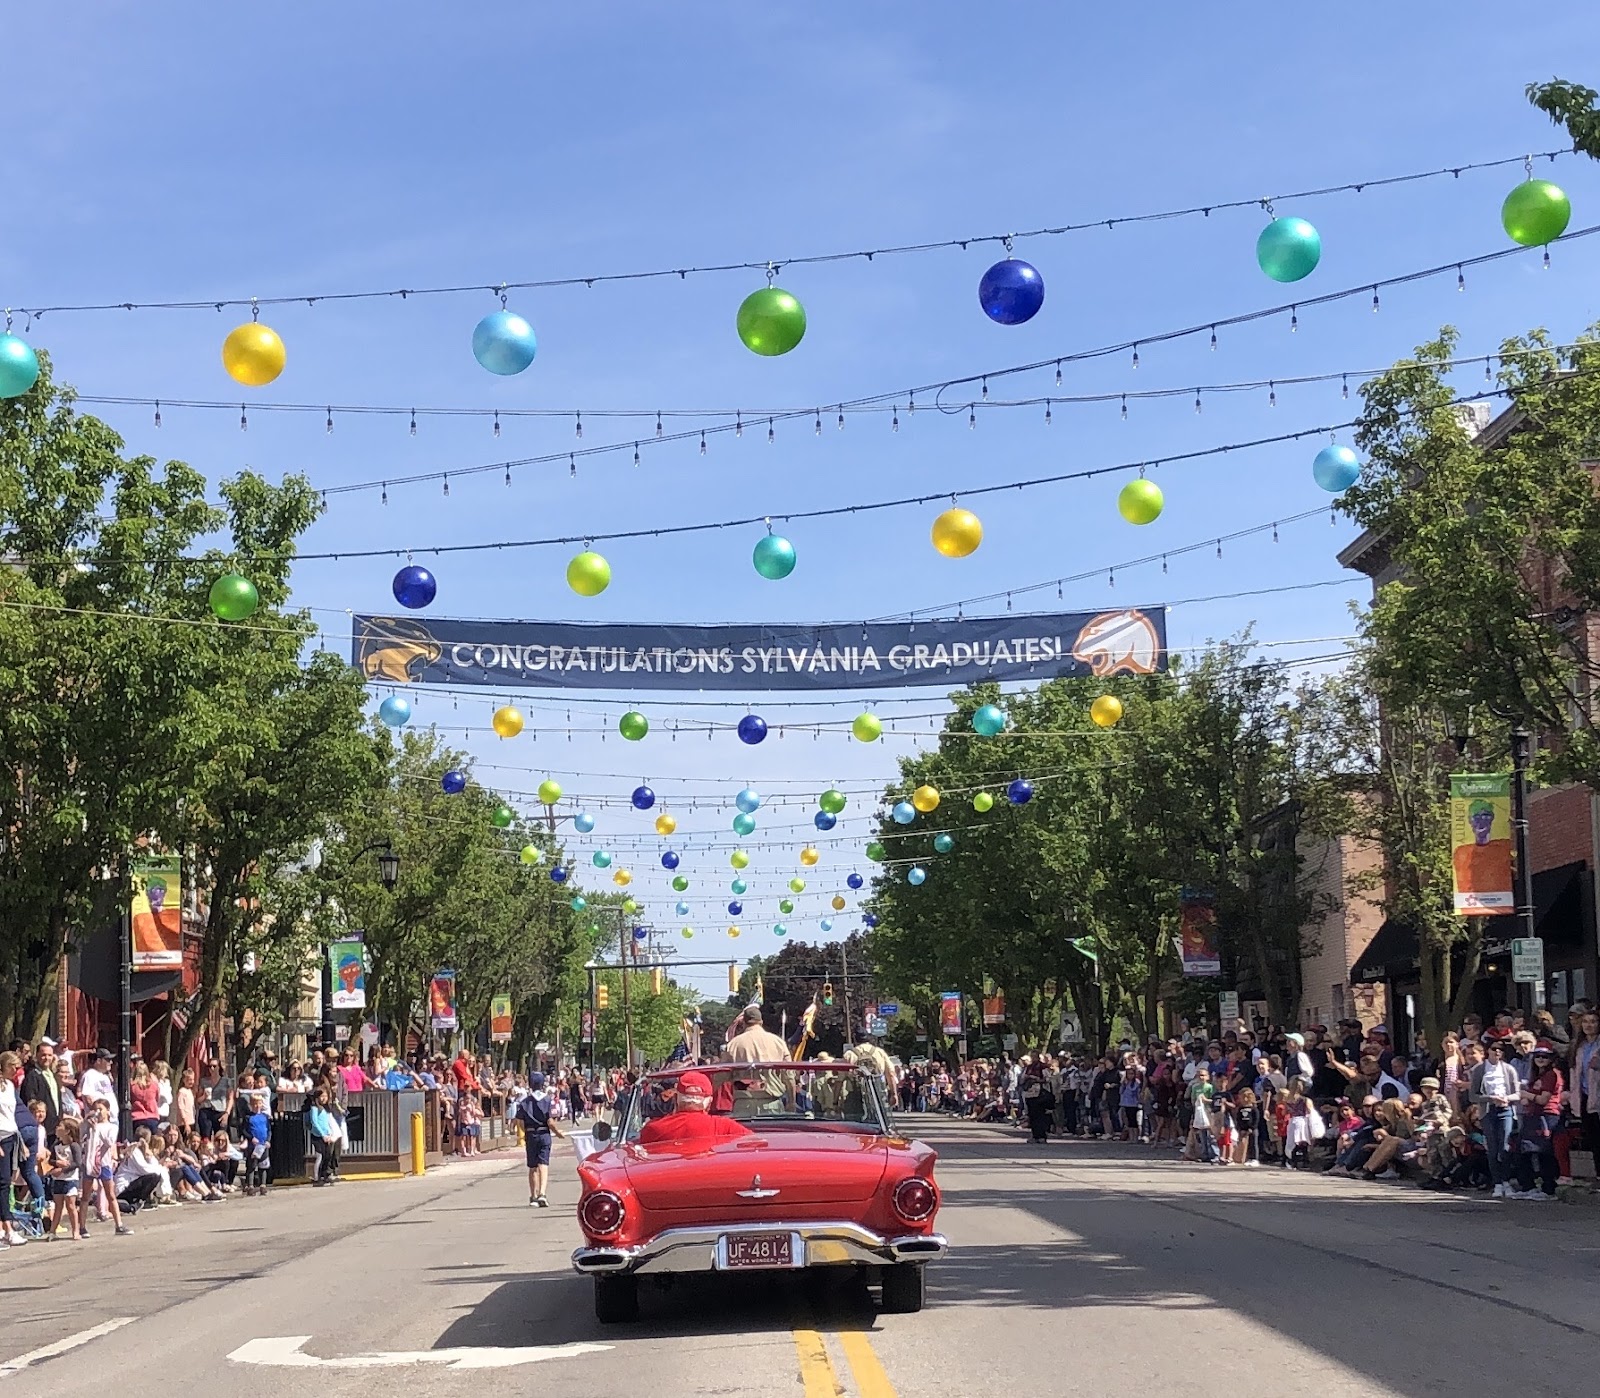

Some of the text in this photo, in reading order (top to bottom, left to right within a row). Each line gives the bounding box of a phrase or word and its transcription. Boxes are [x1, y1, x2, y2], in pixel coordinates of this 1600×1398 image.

[451, 635, 1061, 674] CONGRATULATIONS SYLVANIA GRADUATES!
